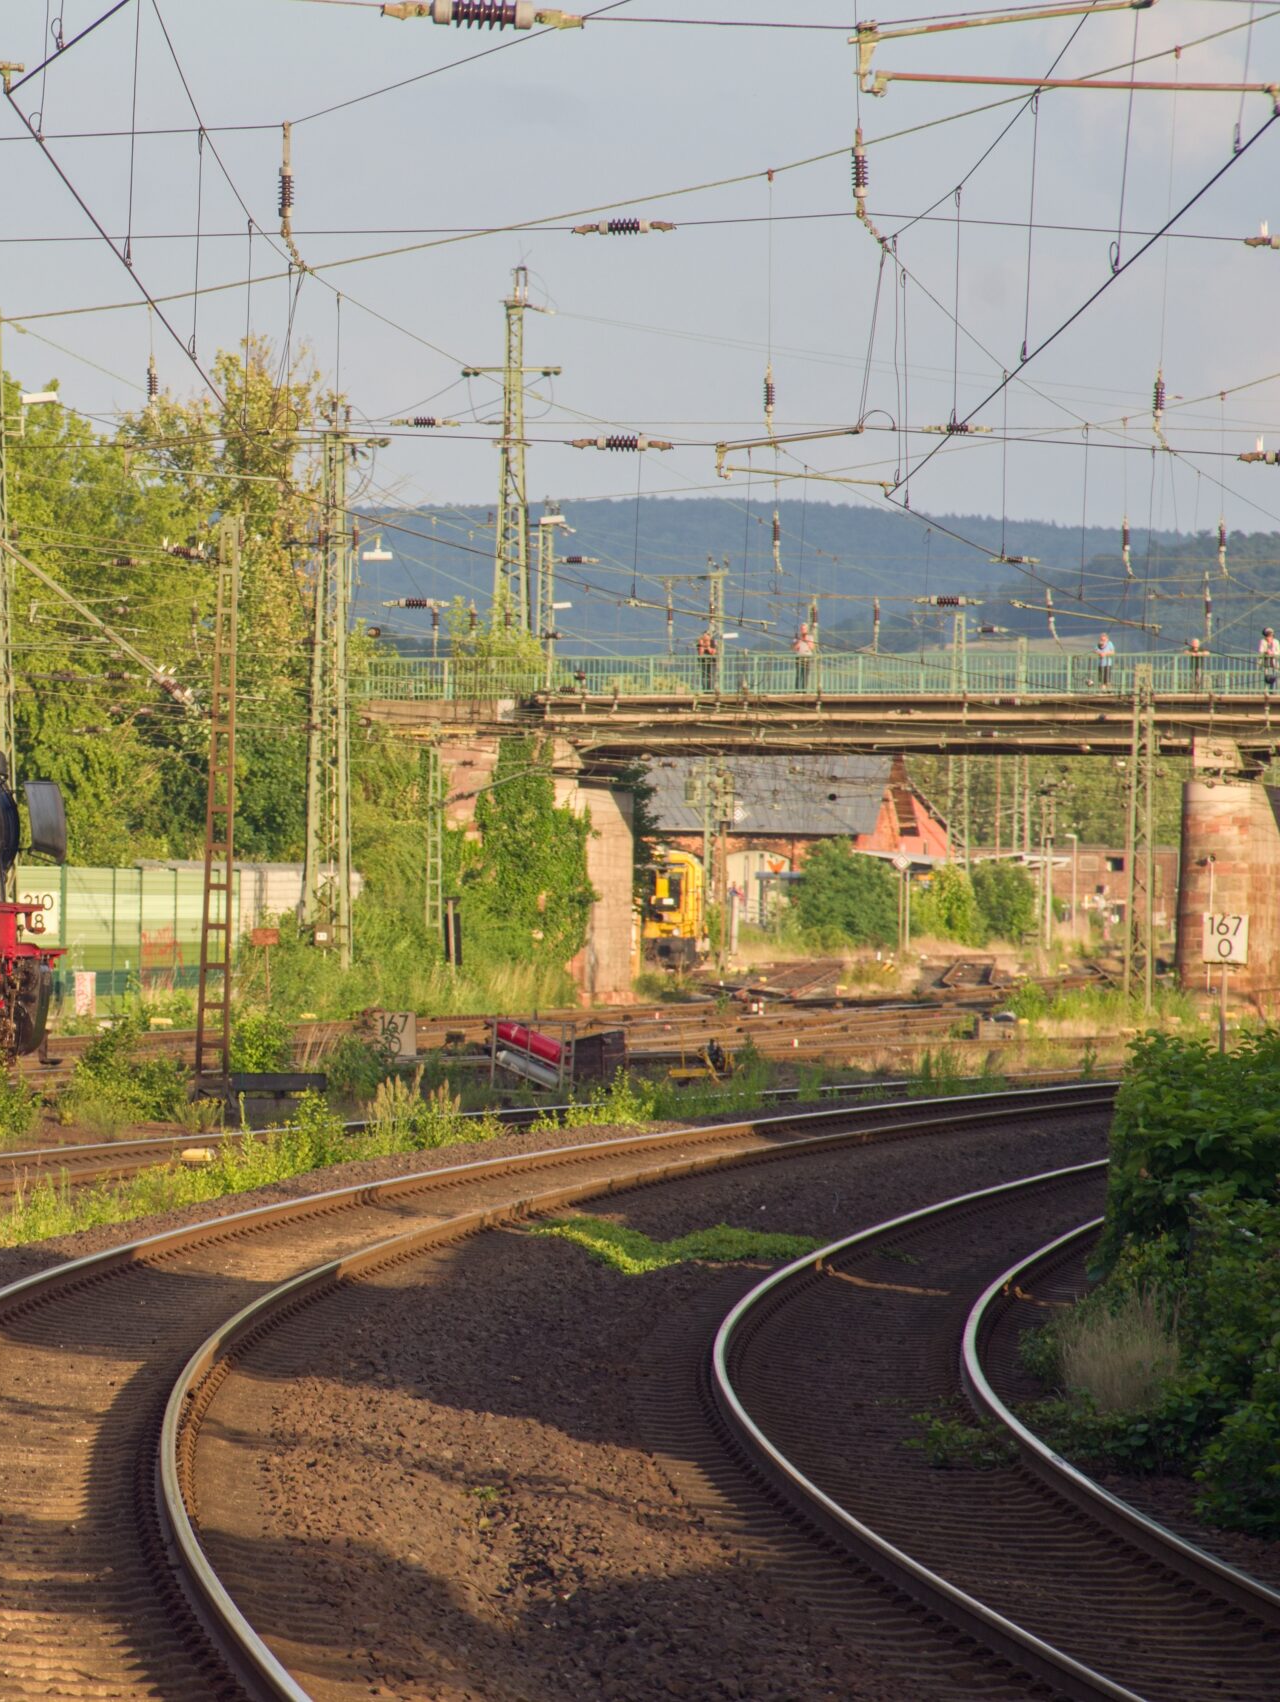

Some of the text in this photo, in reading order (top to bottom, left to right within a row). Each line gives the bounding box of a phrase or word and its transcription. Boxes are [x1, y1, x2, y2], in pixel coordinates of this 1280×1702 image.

[23, 894, 54, 911] 210
[34, 913, 45, 930] 8
[1208, 914, 1243, 936] 167
[1217, 938, 1233, 958] 0
[379, 1014, 409, 1035] 167
